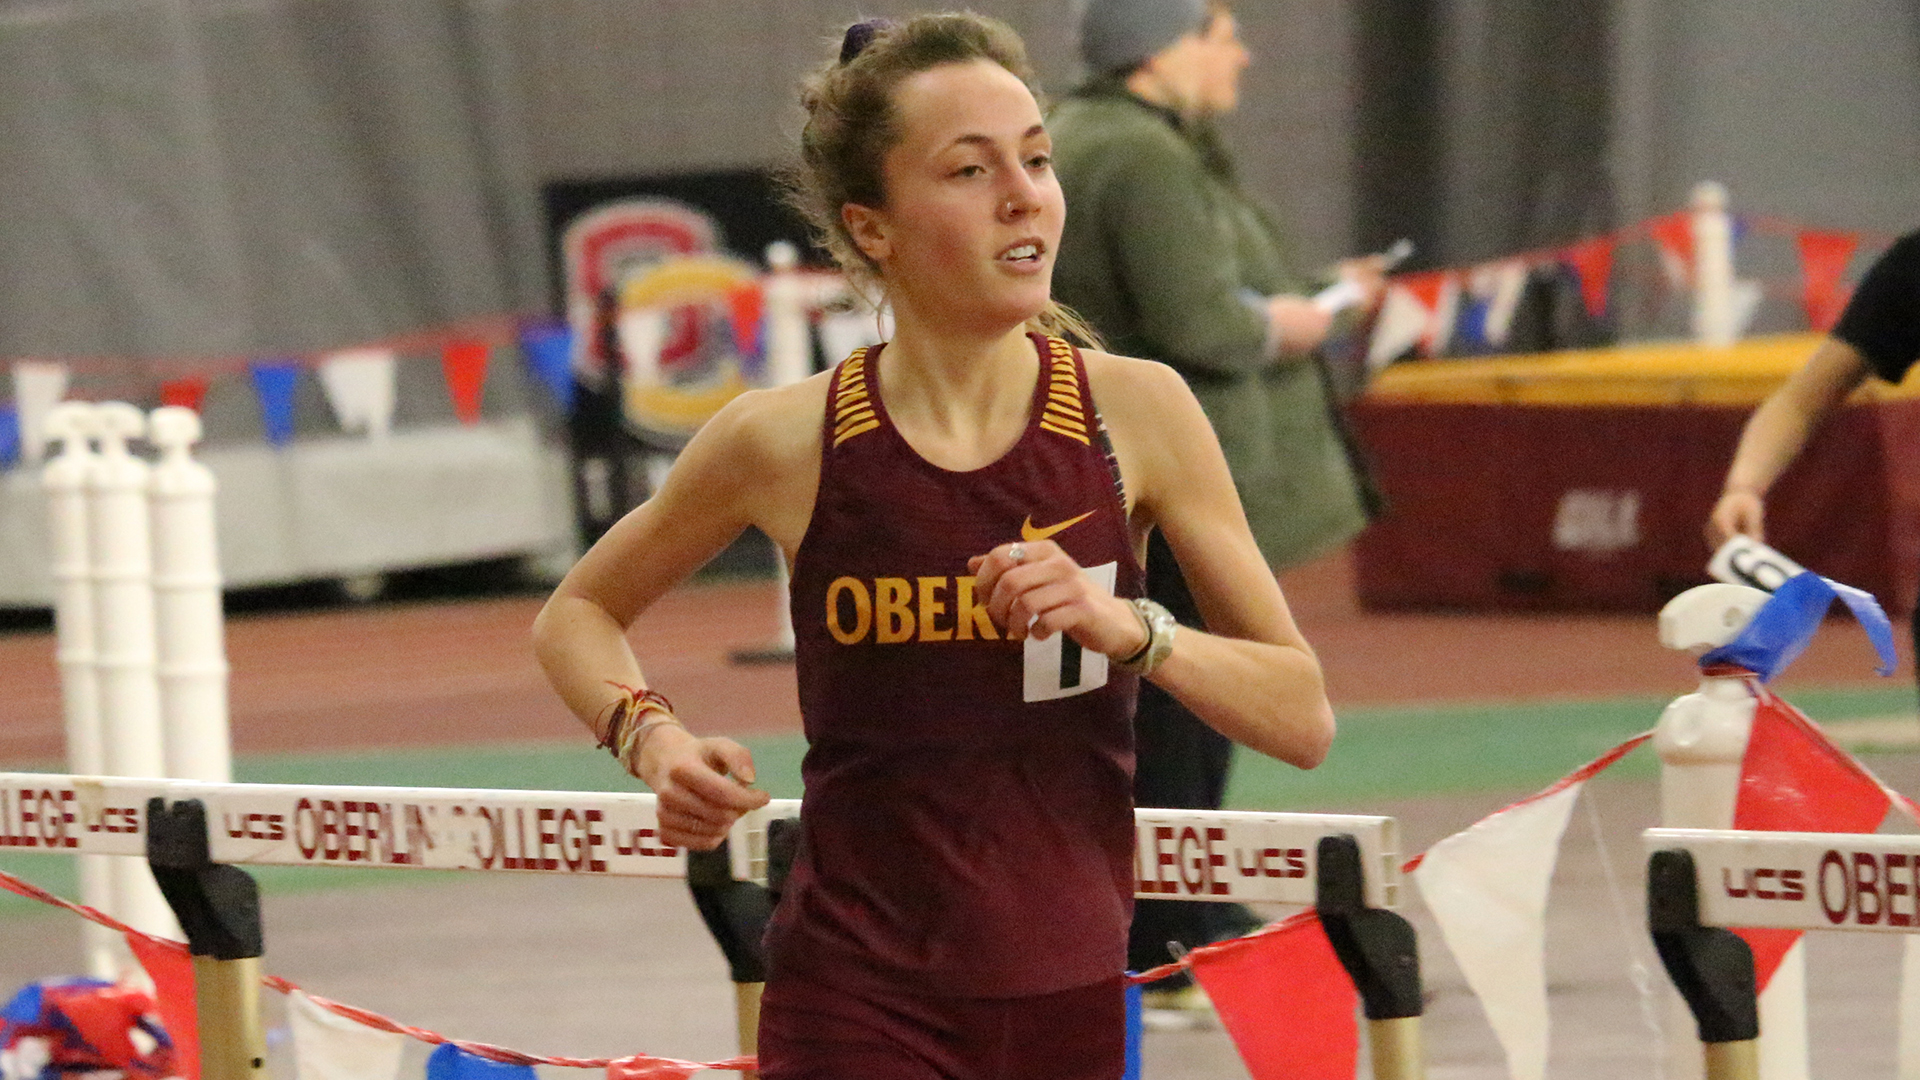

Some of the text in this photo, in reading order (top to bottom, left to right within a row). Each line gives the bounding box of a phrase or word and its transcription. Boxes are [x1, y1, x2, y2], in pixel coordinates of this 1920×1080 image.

[826, 575, 1027, 644] OBER
[0, 788, 79, 848] LEGE
[450, 805, 607, 872] OLLEGE
[1818, 849, 1920, 927] OBE
